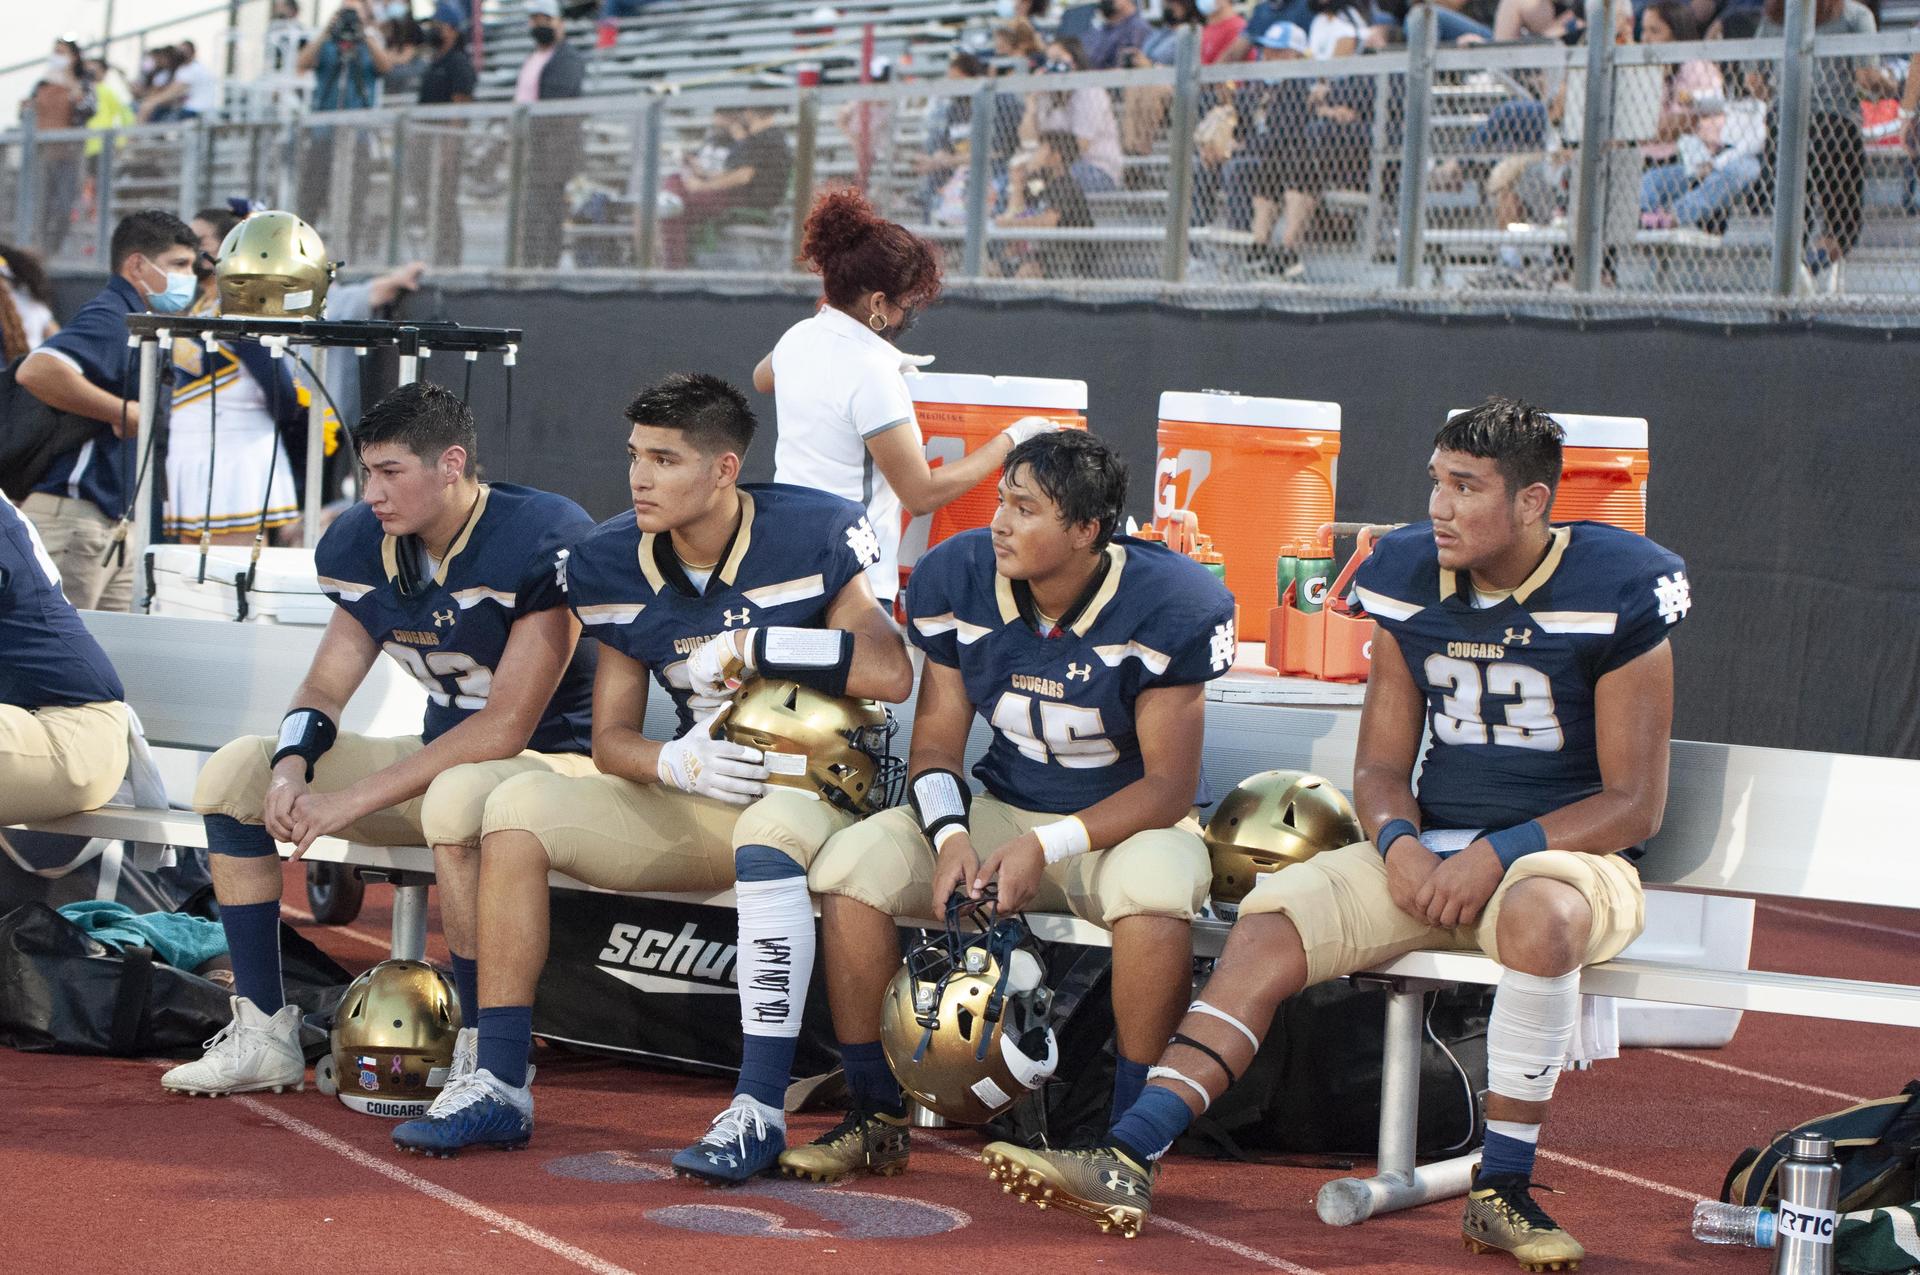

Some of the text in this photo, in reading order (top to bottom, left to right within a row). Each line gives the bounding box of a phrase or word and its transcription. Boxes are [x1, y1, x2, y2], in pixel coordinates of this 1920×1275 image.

[1303, 576, 1328, 605] G
[392, 629, 440, 646] COUGARS
[1447, 641, 1505, 659] COUGARS
[1011, 673, 1065, 699] COUGARS
[1424, 652, 1565, 751] 33
[991, 691, 1121, 769] 45
[749, 969, 791, 998] NOT
[366, 1101, 425, 1117] COUGARS
[1780, 1207, 1833, 1237] RTIC
